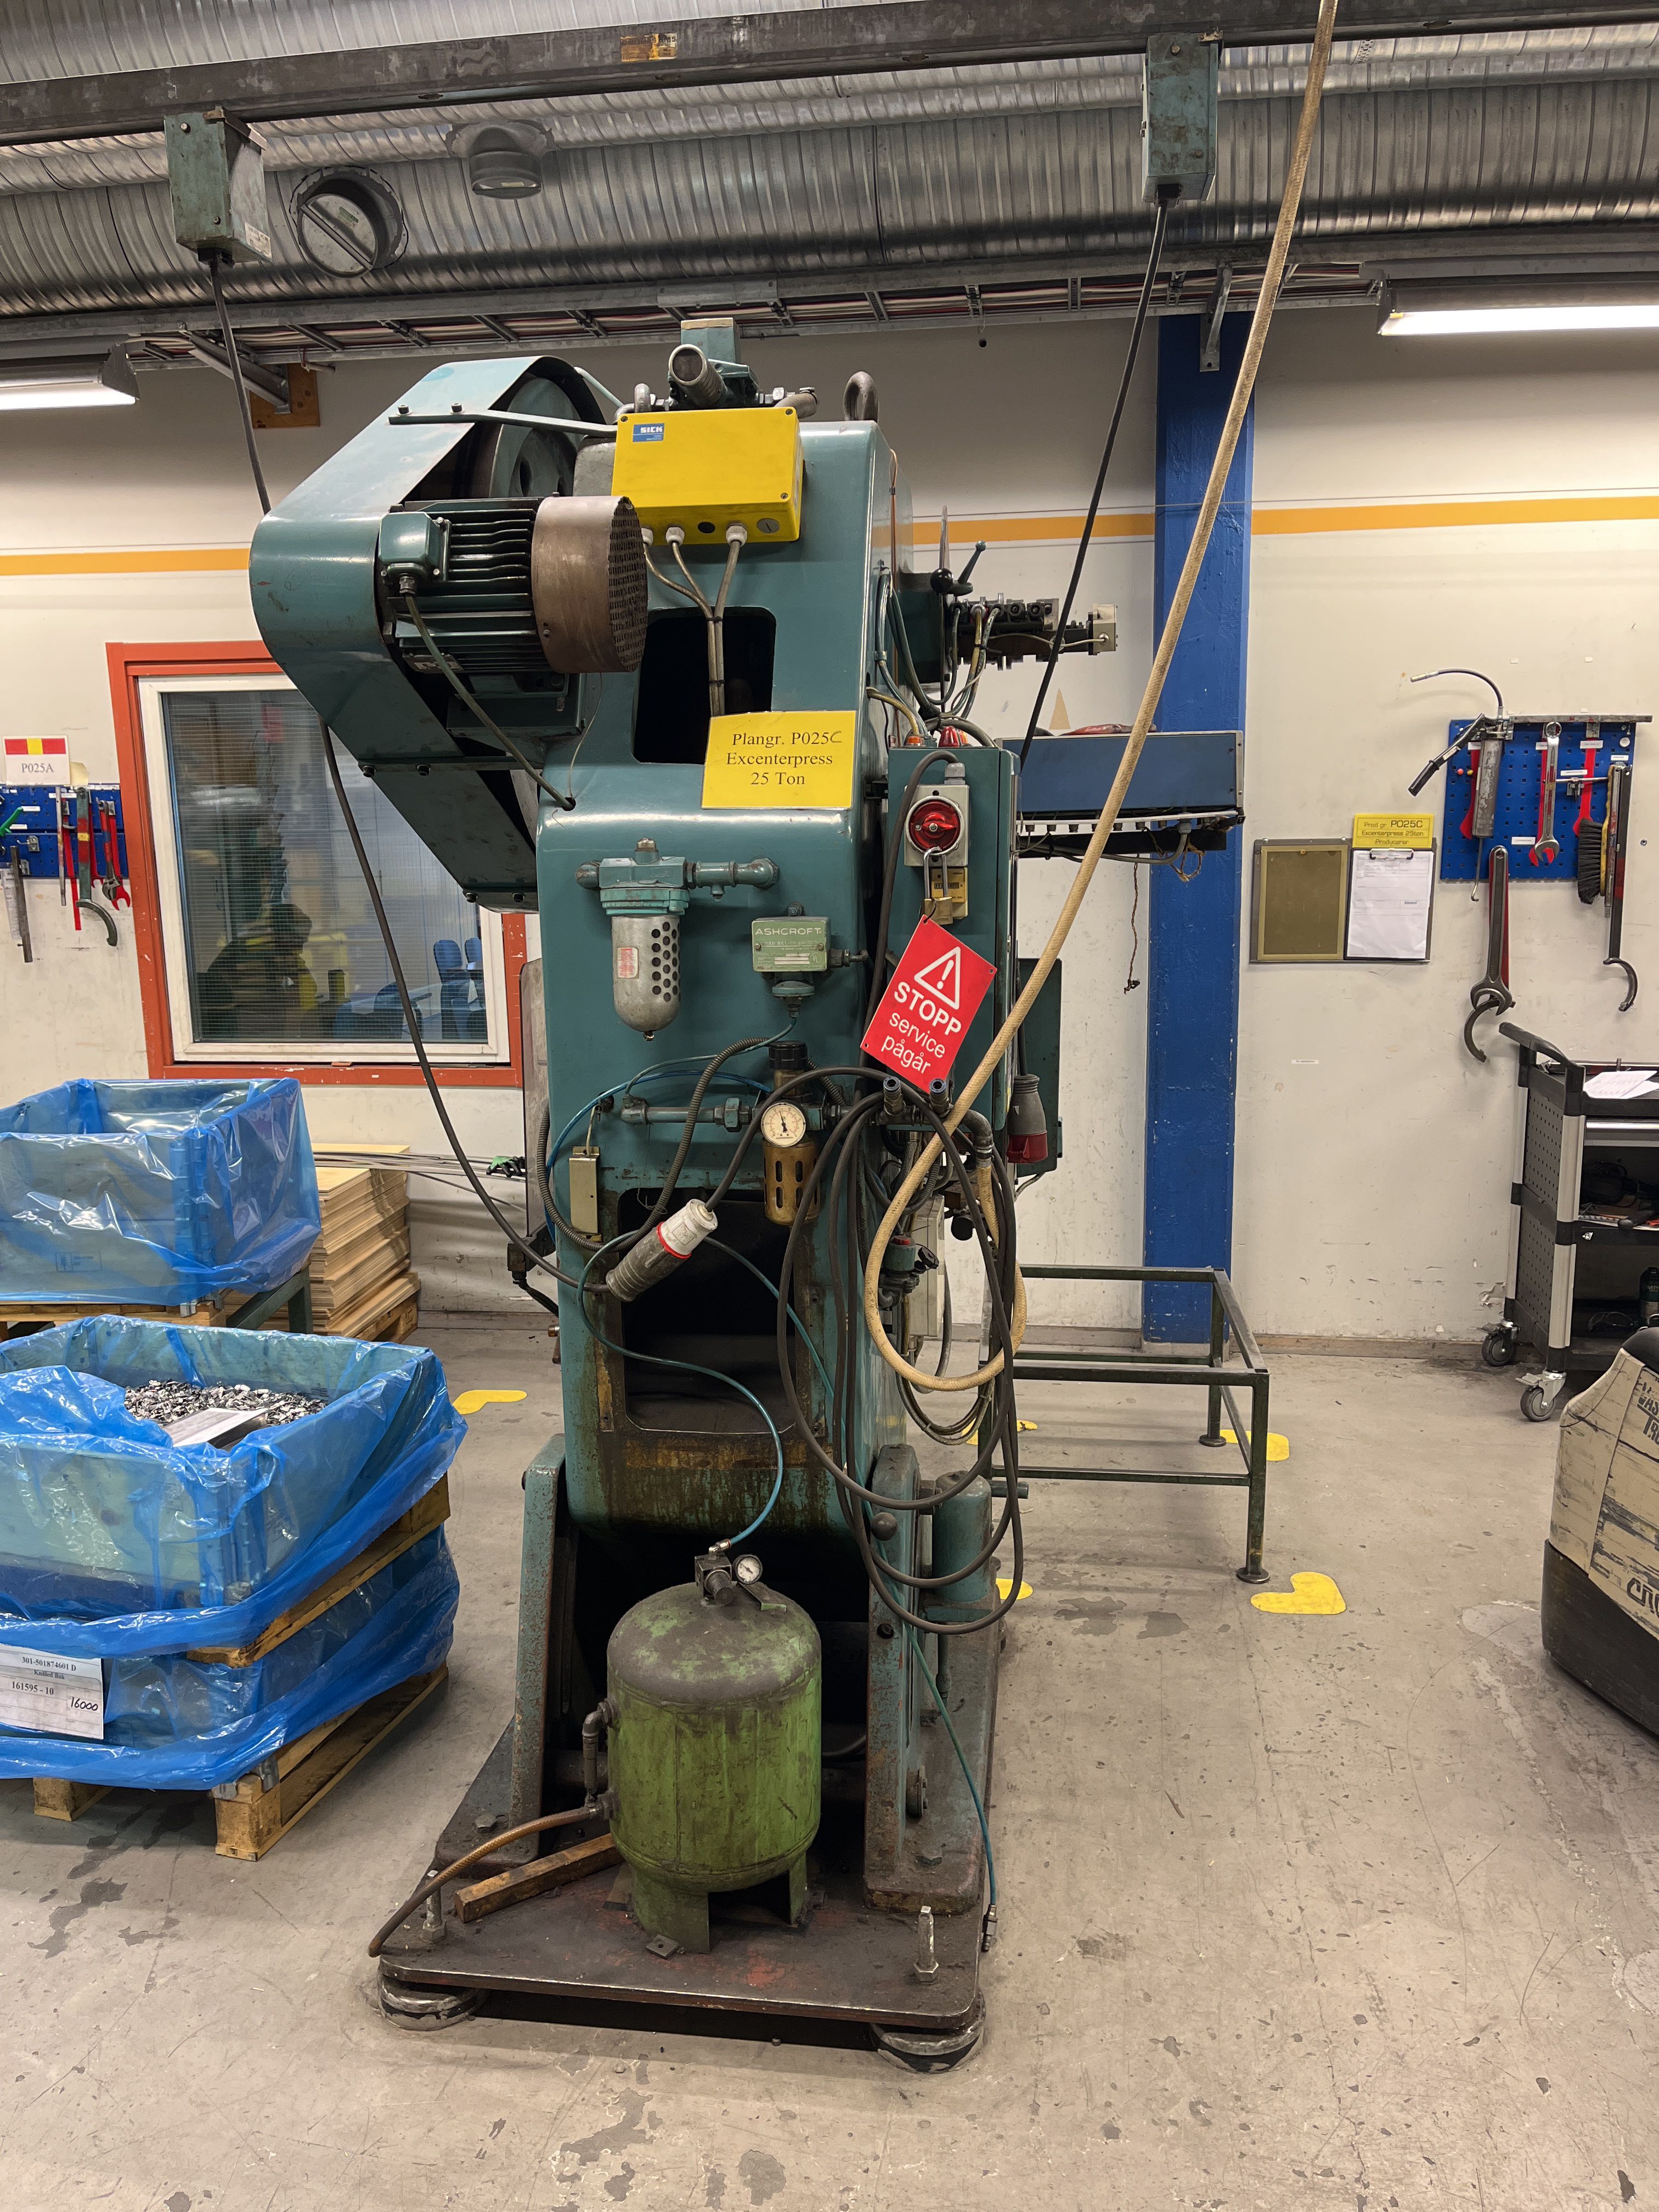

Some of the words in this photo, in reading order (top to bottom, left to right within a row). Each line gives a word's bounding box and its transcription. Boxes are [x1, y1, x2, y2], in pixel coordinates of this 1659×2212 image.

[732, 732, 785, 748] Plangr.
[791, 730, 842, 745] P025C
[726, 752, 833, 768] Excenterpress
[21, 763, 54, 773] P025A
[751, 772, 769, 785] 25
[775, 772, 805, 785] Ton
[755, 927, 822, 935] ASHCROFT
[894, 981, 962, 1036] STOPP
[889, 1012, 946, 1058] service
[880, 1035, 931, 1074] pågår
[21, 1656, 69, 1670] 301-501874601
[12, 1681, 38, 1693] 161595
[46, 1686, 54, 1696] 10
[71, 1696, 99, 1711] 16000
